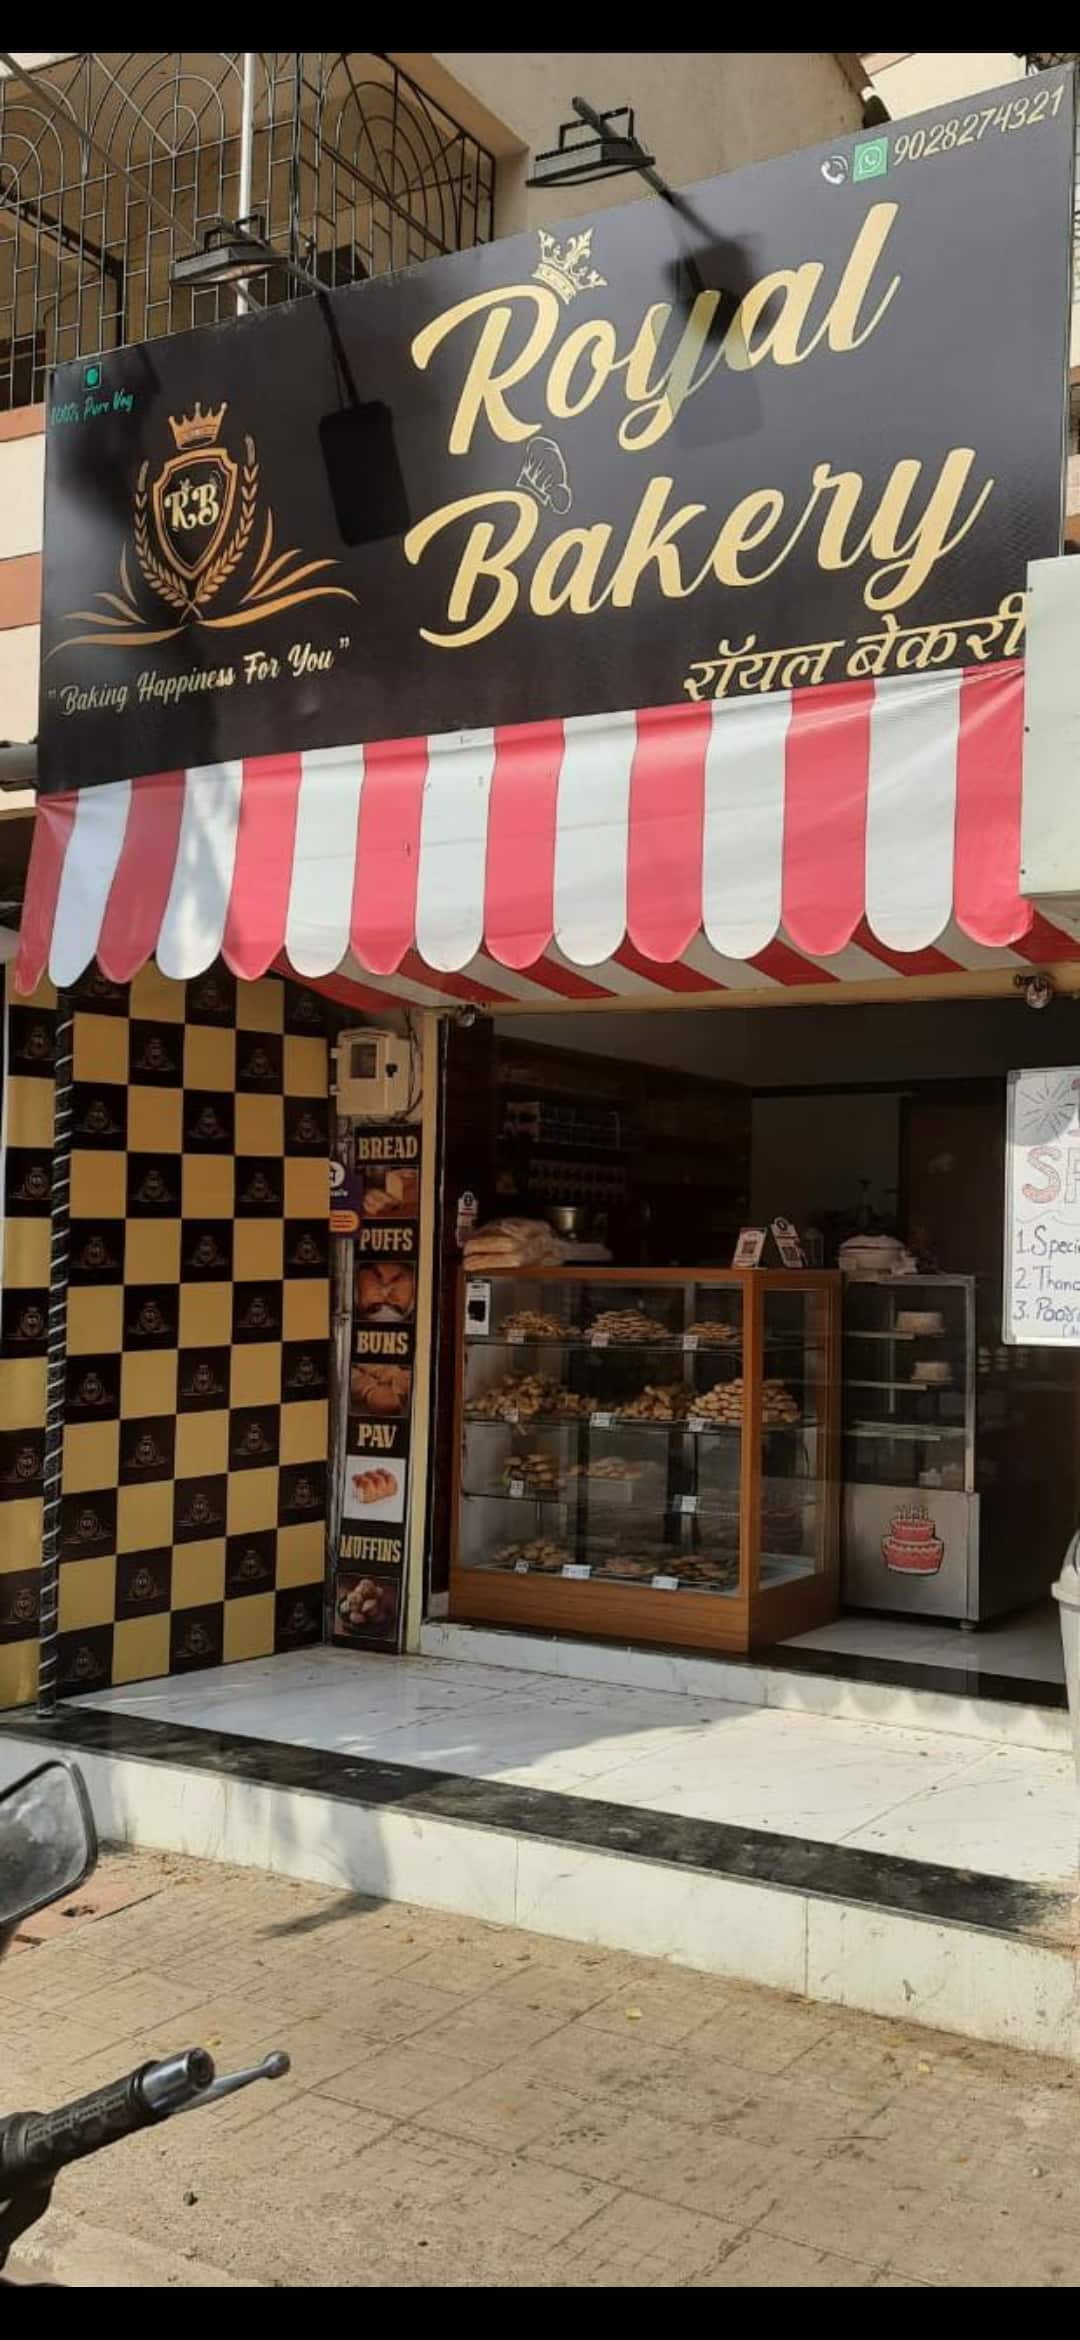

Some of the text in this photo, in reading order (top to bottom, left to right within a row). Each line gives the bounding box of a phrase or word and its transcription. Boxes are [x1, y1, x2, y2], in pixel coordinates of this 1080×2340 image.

[893, 84, 1065, 167] 9028274321
[411, 202, 901, 455] Royal
[112, 388, 134, 413] Veg
[164, 483, 219, 532] RB
[404, 446, 995, 649] Bakery
[683, 591, 1027, 702] रॉयल बेकरी
[137, 667, 236, 704] Happiness
[243, 650, 280, 685] For
[358, 1137, 418, 1160] BREAD
[360, 1228, 413, 1251] PUFFS
[357, 1331, 409, 1354] BUNS
[357, 1423, 398, 1449] PAV
[339, 1534, 402, 1564] MUFFINS
